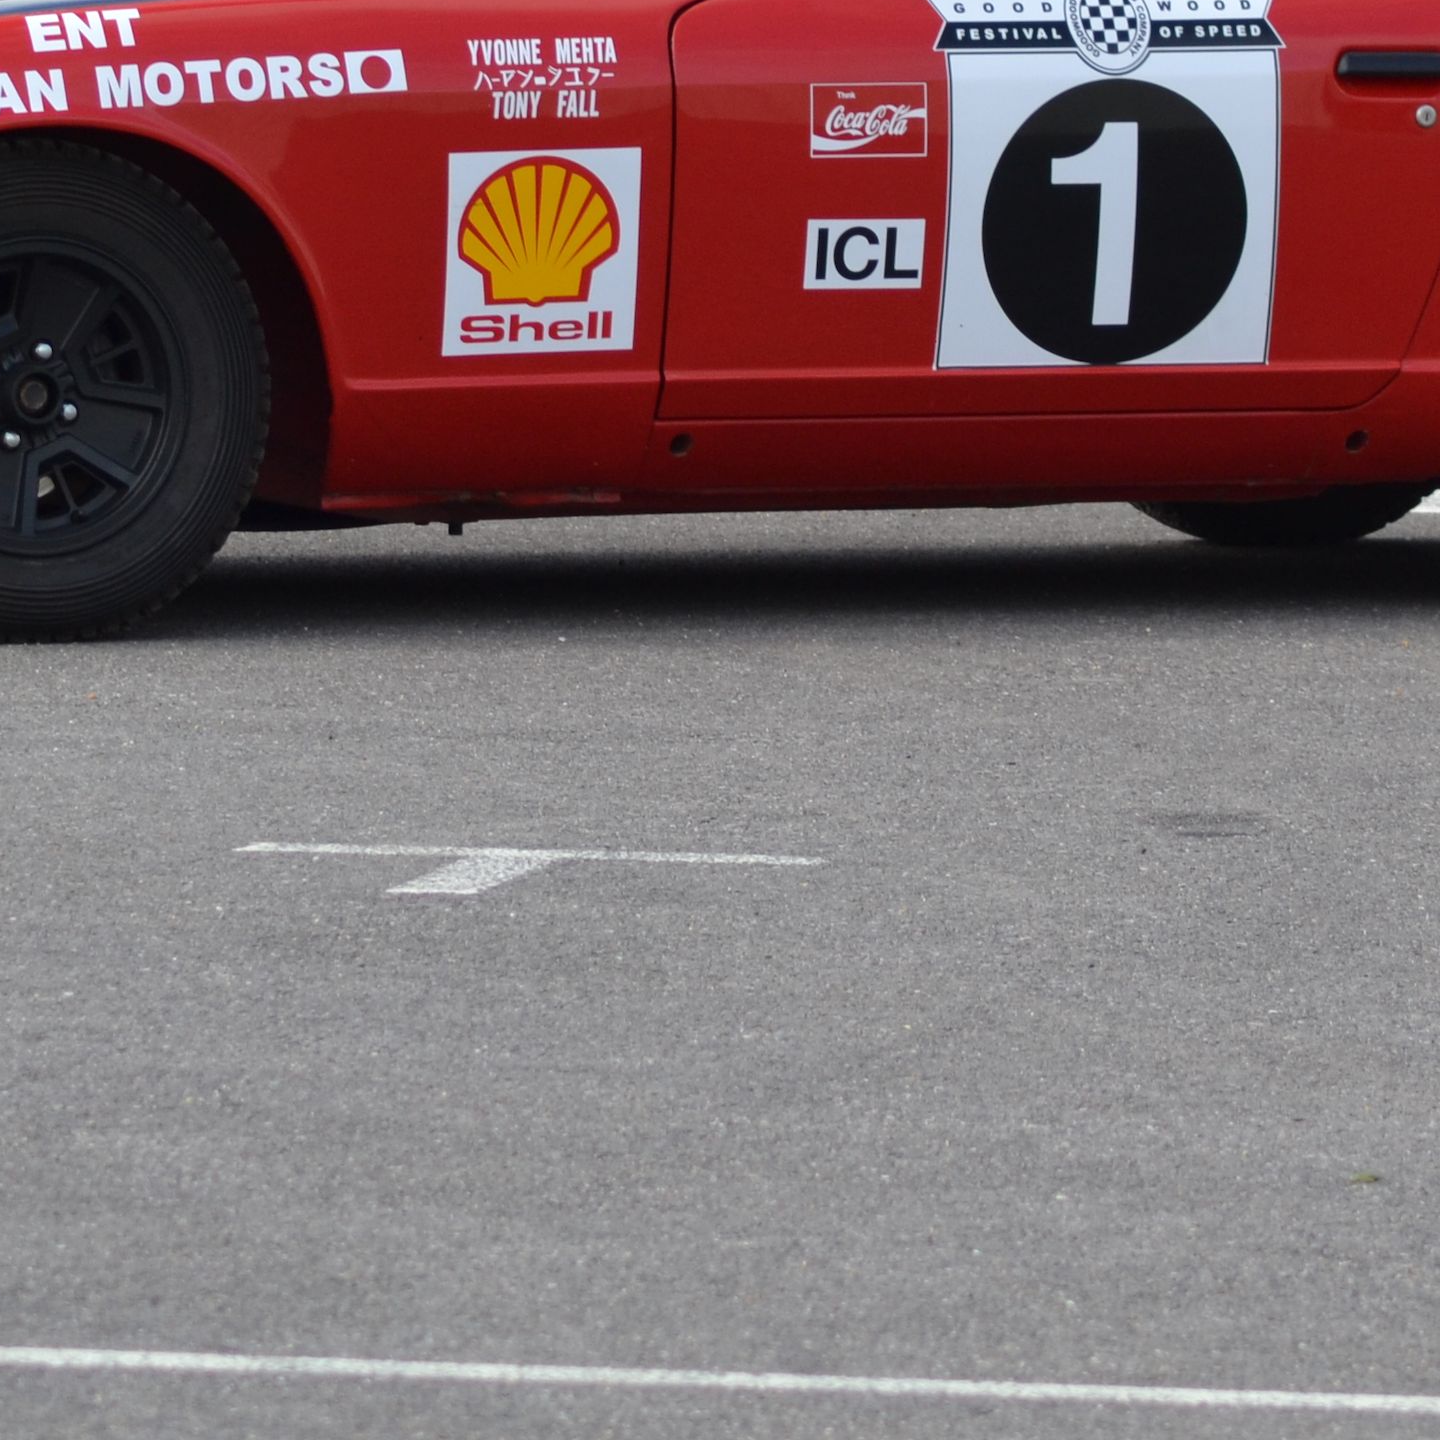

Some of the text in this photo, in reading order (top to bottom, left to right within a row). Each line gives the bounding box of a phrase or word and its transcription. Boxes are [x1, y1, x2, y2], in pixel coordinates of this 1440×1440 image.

[24, 8, 141, 53] ENT
[466, 36, 618, 66] YVONNE MEHTA
[955, 23, 1262, 41] FESTIVAL OF SPEED
[1128, 4, 1148, 57] COMPANY
[96, 51, 346, 110] MOTORS
[491, 88, 600, 120] TONY FALL
[1050, 121, 1139, 326] 1
[814, 226, 919, 282] ICL
[459, 310, 613, 344] Shell
